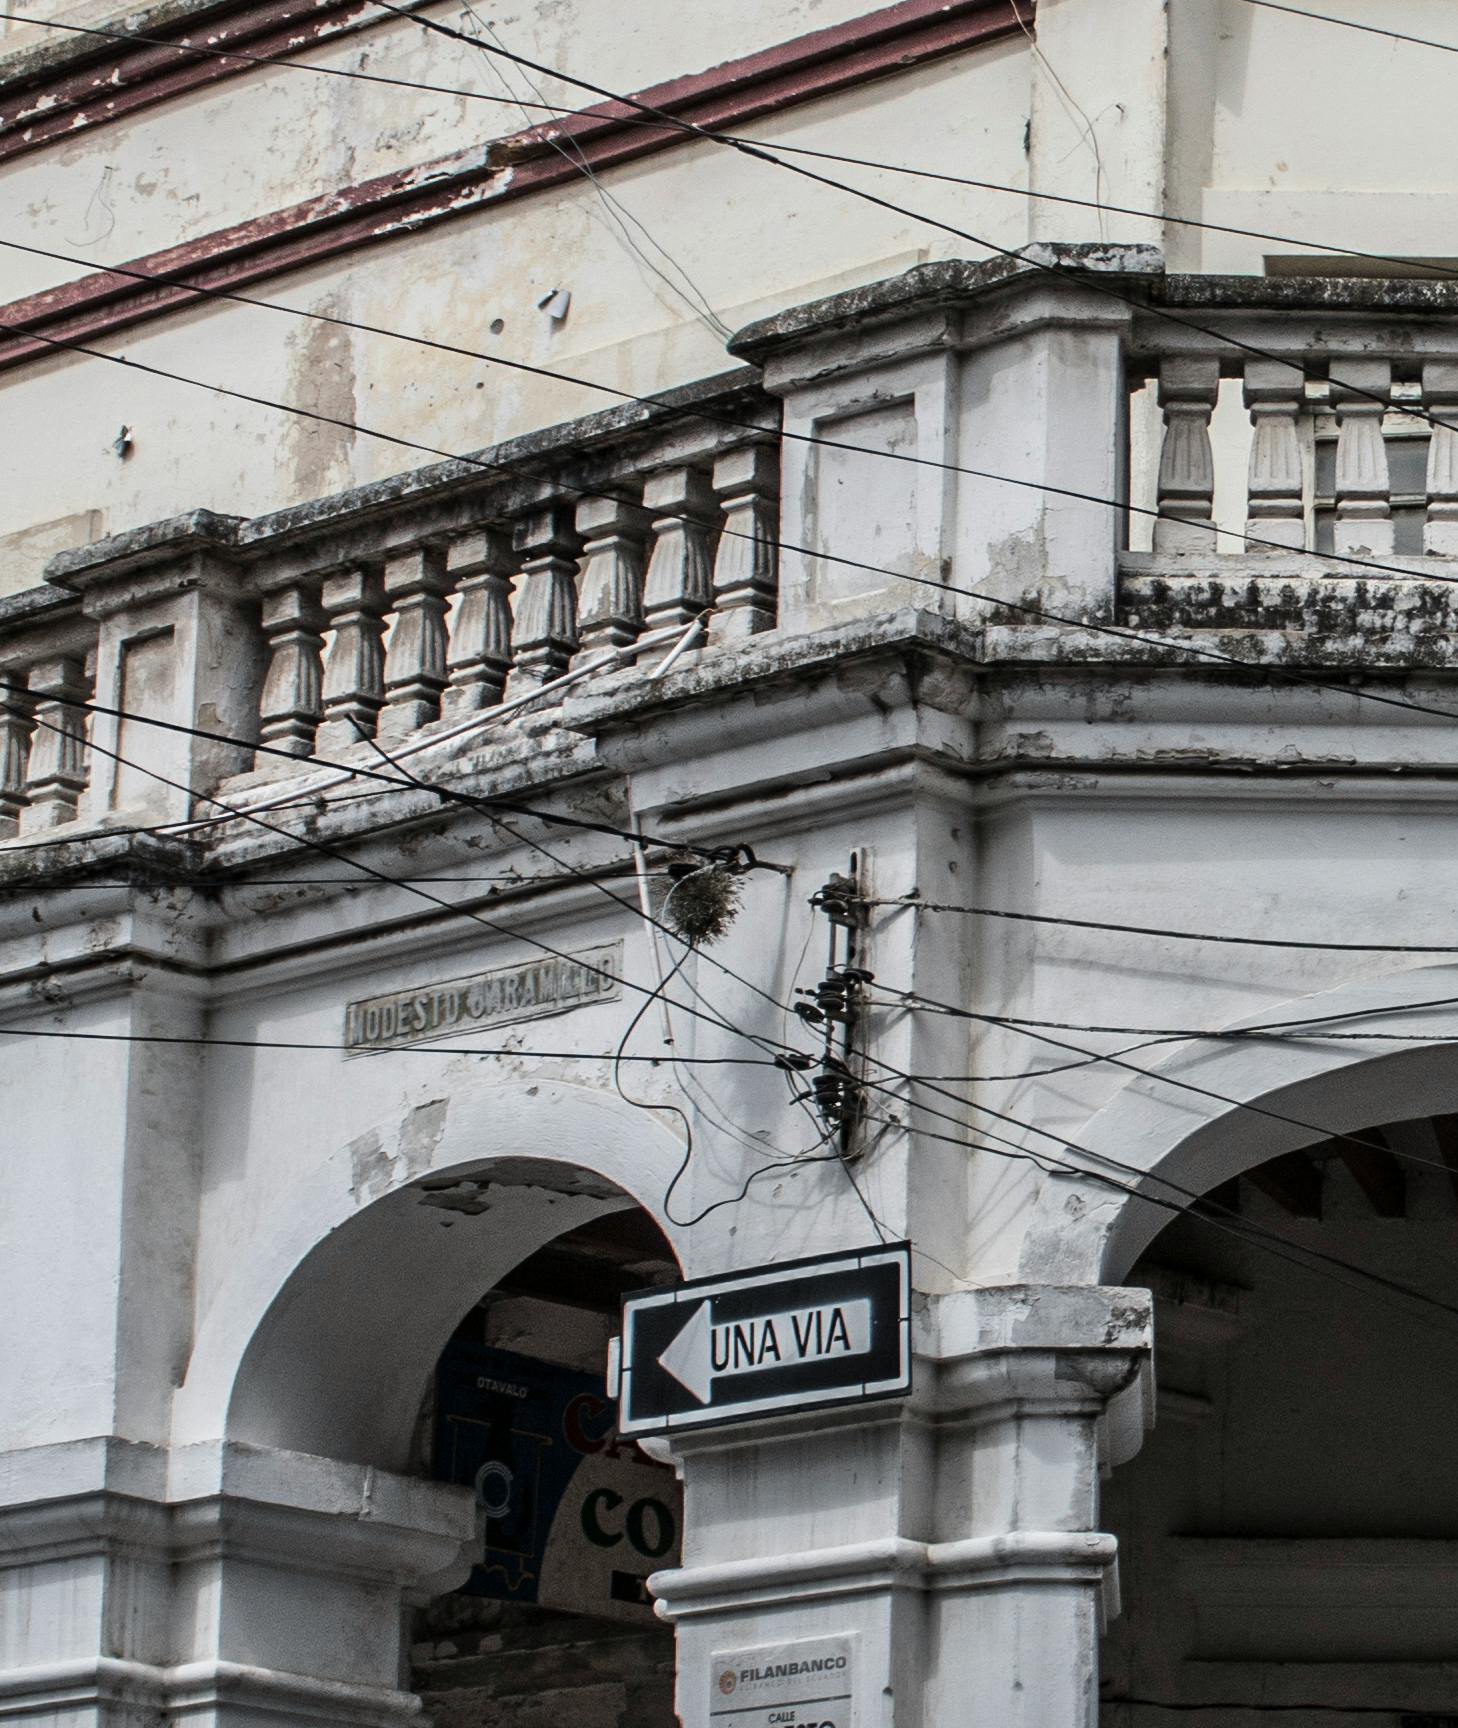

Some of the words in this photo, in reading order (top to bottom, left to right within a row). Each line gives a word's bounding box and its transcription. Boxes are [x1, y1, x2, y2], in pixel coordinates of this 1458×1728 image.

[351, 989, 461, 1045] MODESTO
[710, 1318, 782, 1372] UNA
[790, 1307, 852, 1358] VIA
[477, 1375, 529, 1399] OTAVALO
[740, 1655, 848, 1684] FILANBANCO
[768, 1710, 796, 1725] CALLE
